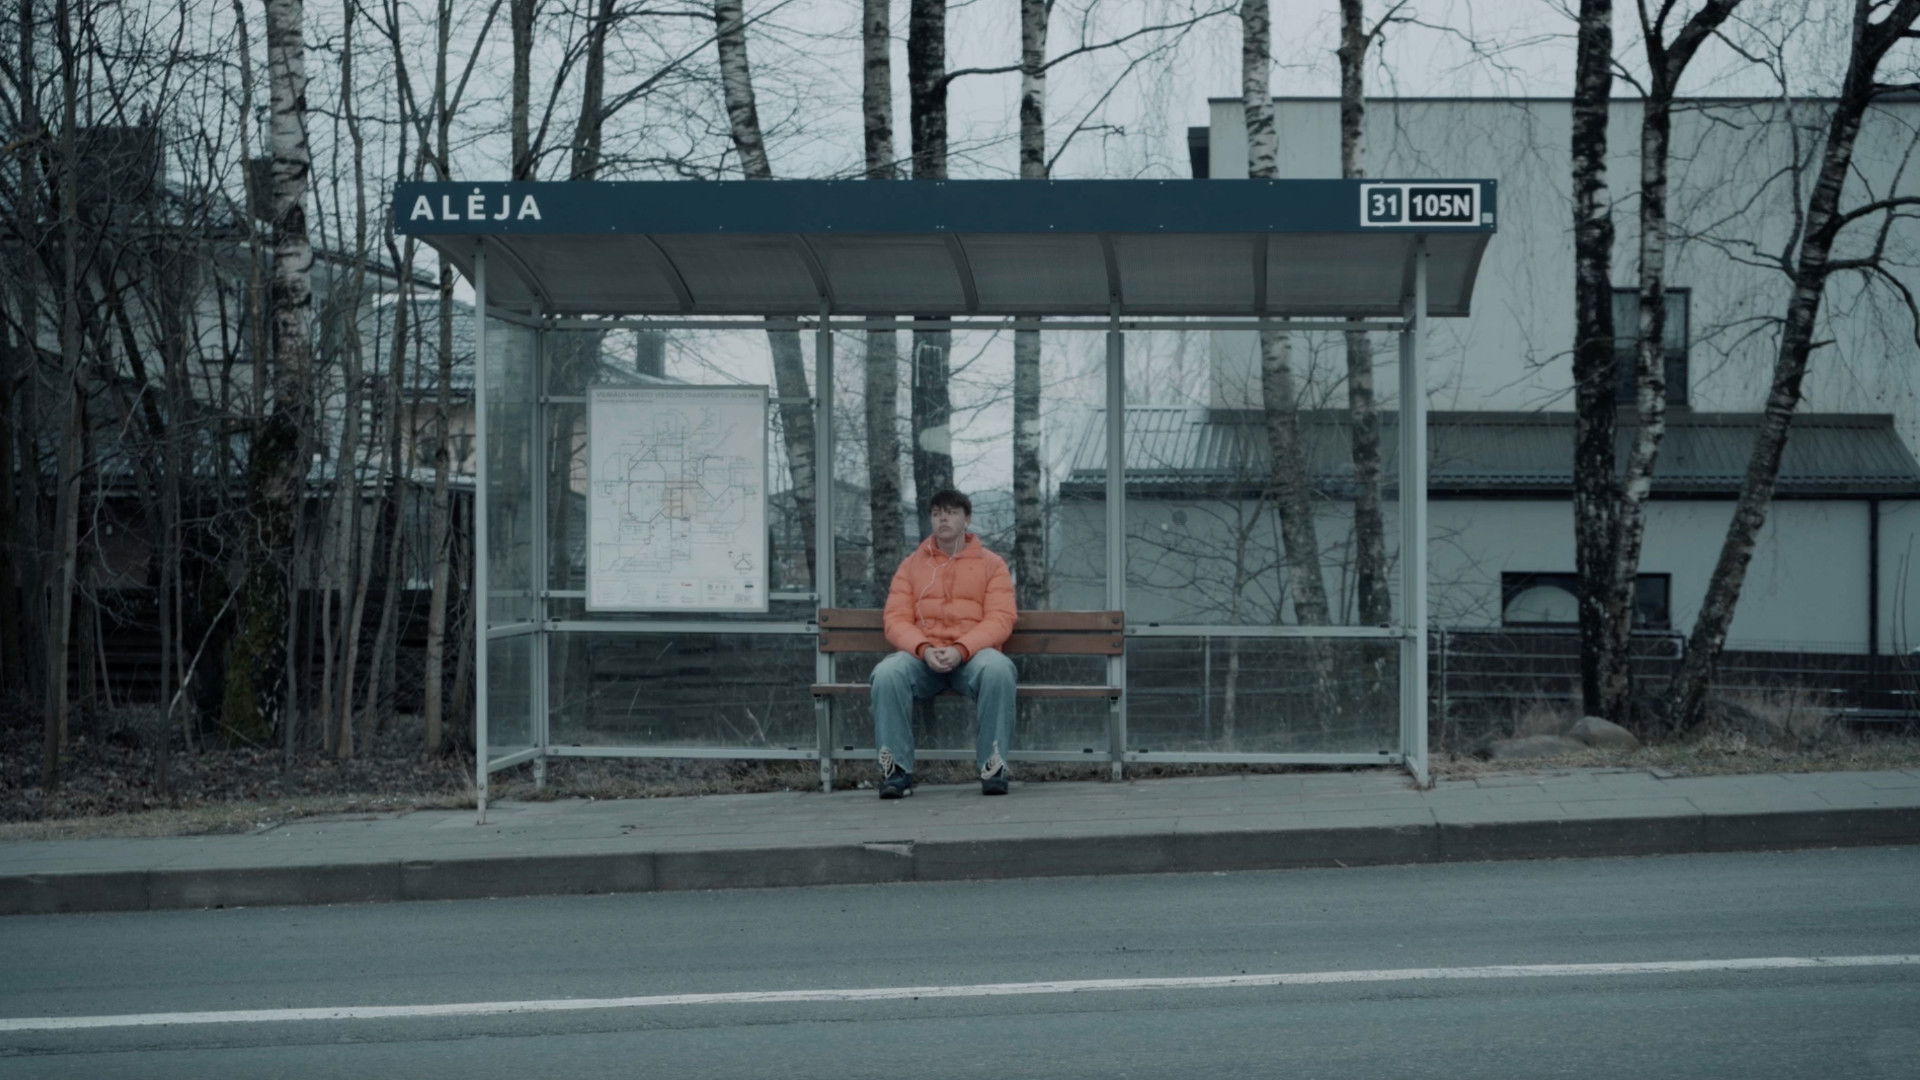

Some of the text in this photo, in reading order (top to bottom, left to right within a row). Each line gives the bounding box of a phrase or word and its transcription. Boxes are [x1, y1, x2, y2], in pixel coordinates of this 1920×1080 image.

[410, 187, 542, 221] ALĖJA
[1372, 193, 1471, 217] 31 105N
